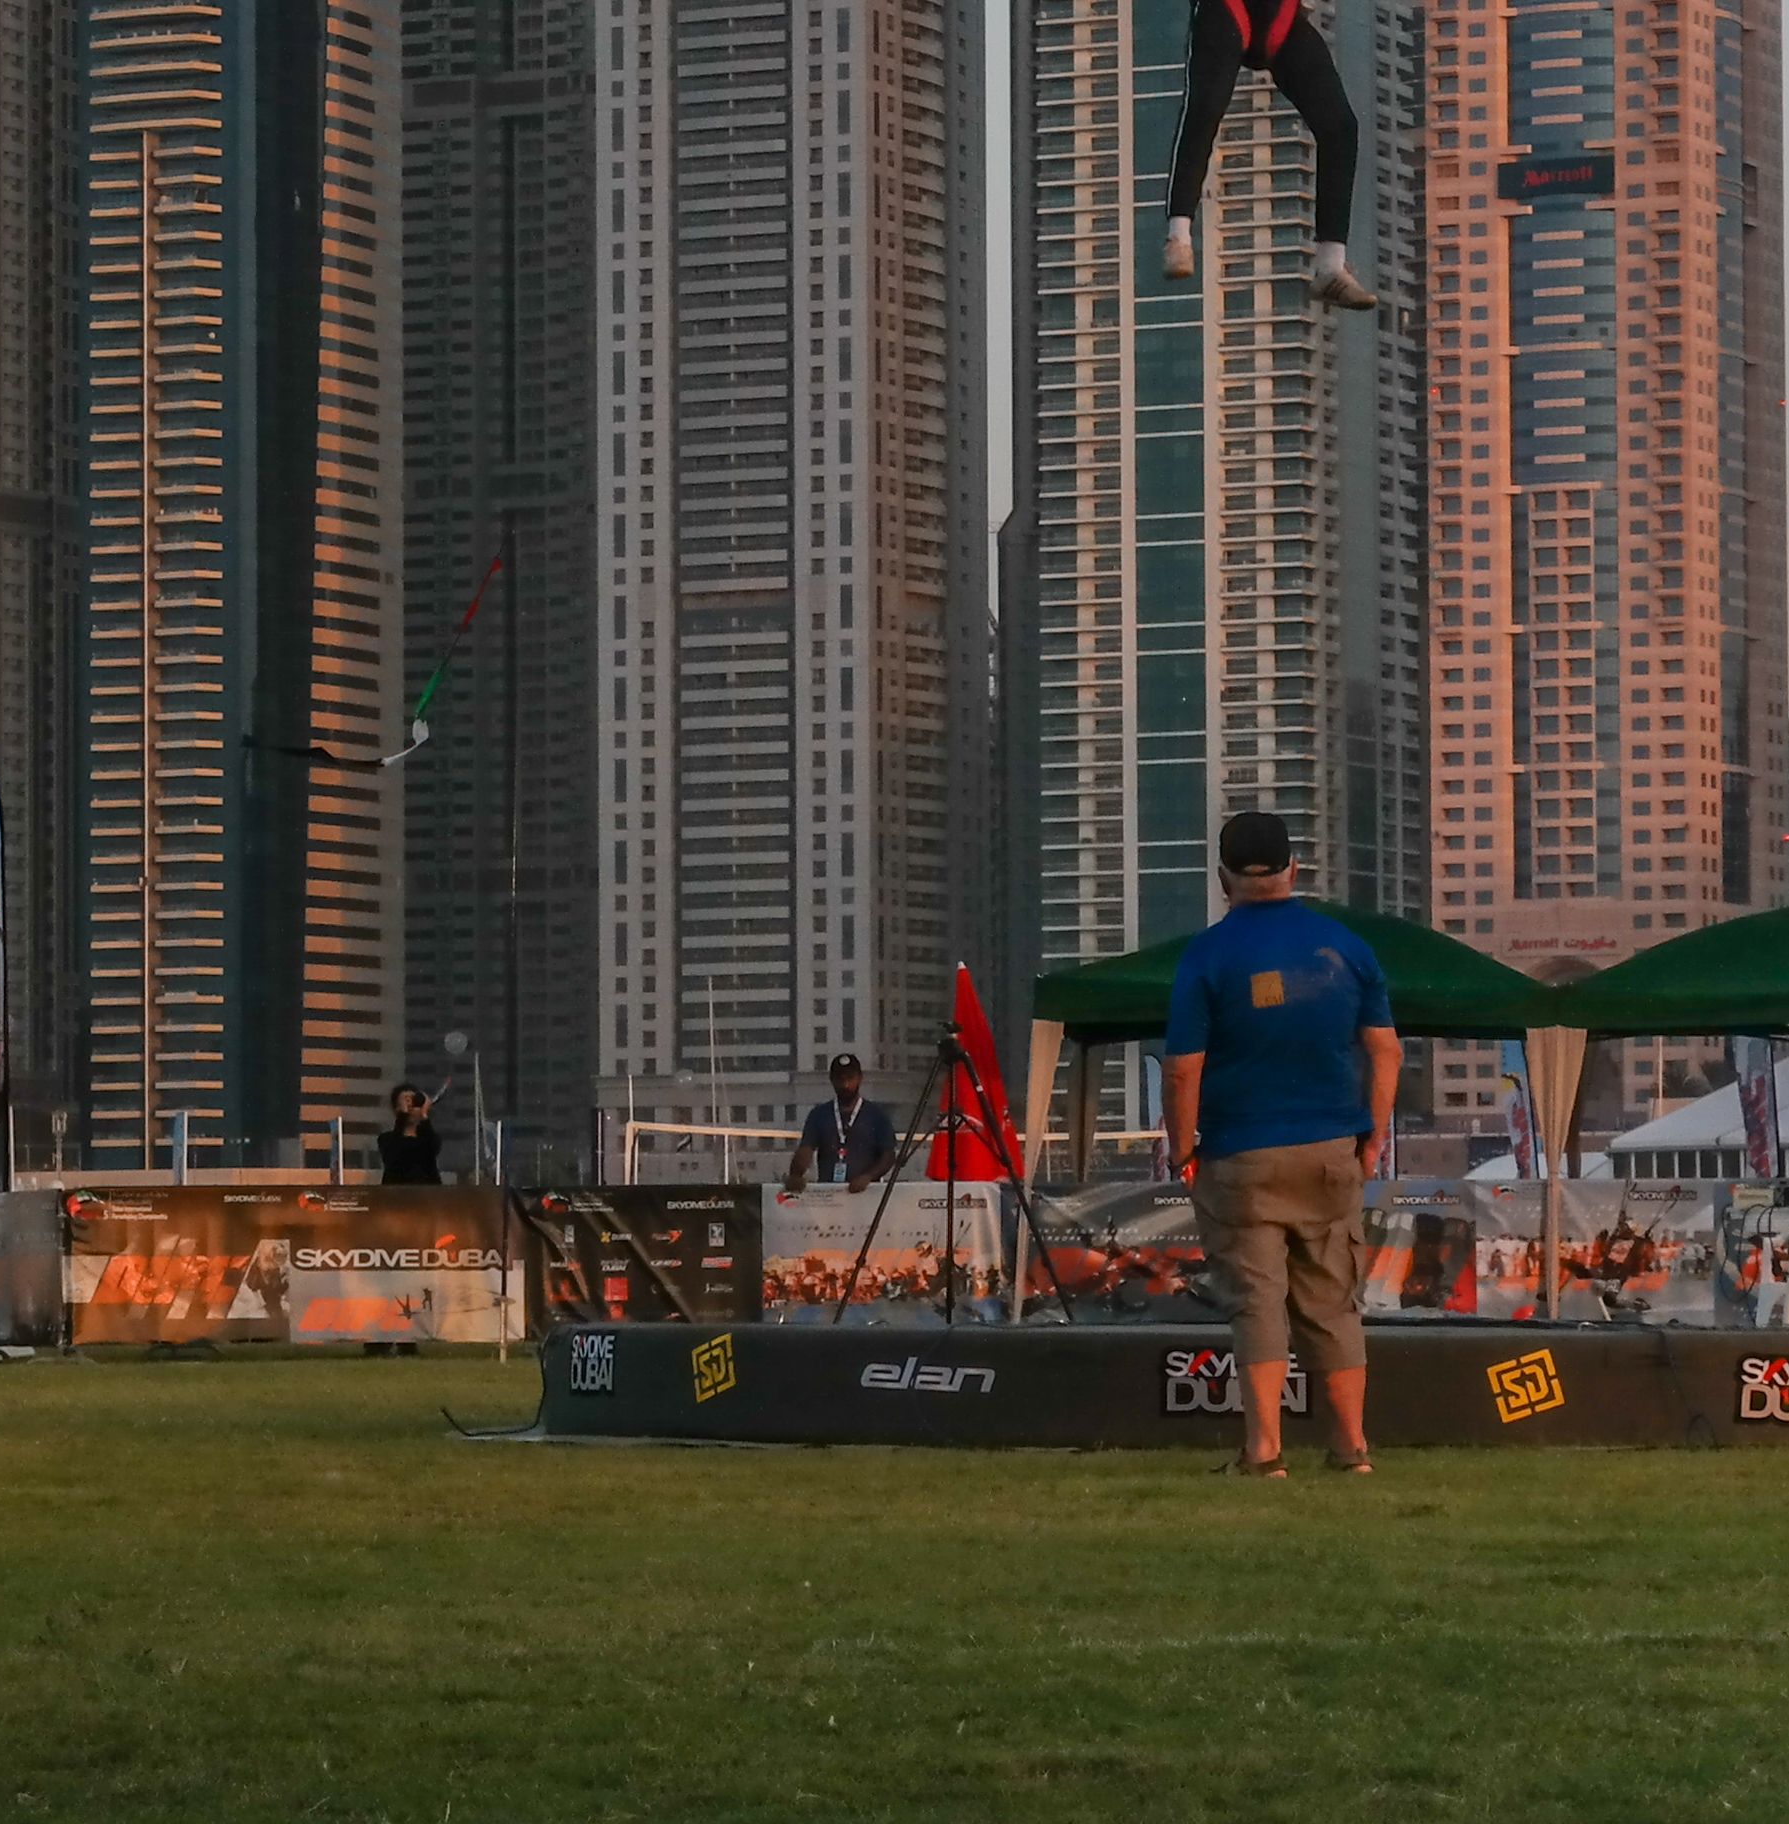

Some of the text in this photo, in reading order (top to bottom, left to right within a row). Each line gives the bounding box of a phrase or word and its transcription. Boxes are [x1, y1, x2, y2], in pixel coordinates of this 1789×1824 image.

[571, 1334, 616, 1358] SKYDIVE
[571, 1358, 614, 1391] DUBAI
[859, 1355, 996, 1394] elan
